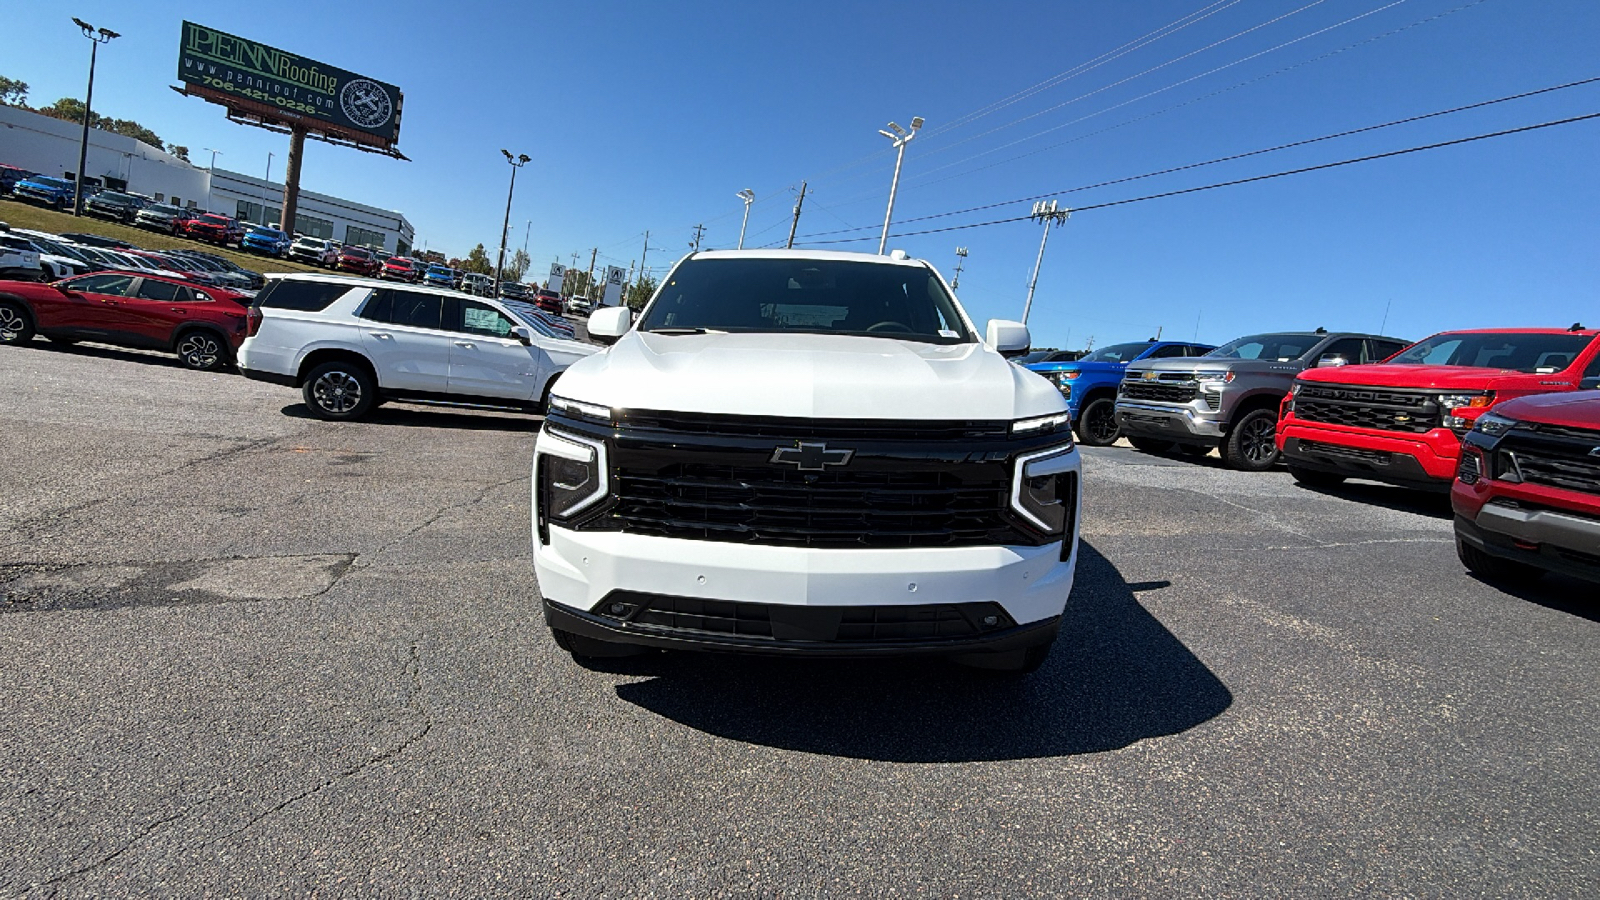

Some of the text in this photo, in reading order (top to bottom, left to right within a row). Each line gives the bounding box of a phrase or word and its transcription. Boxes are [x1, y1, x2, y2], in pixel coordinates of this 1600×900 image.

[186, 24, 338, 96] PENN Roofing
[202, 75, 316, 114] 706-421-0226
[1300, 387, 1429, 406] CHEVROLET
